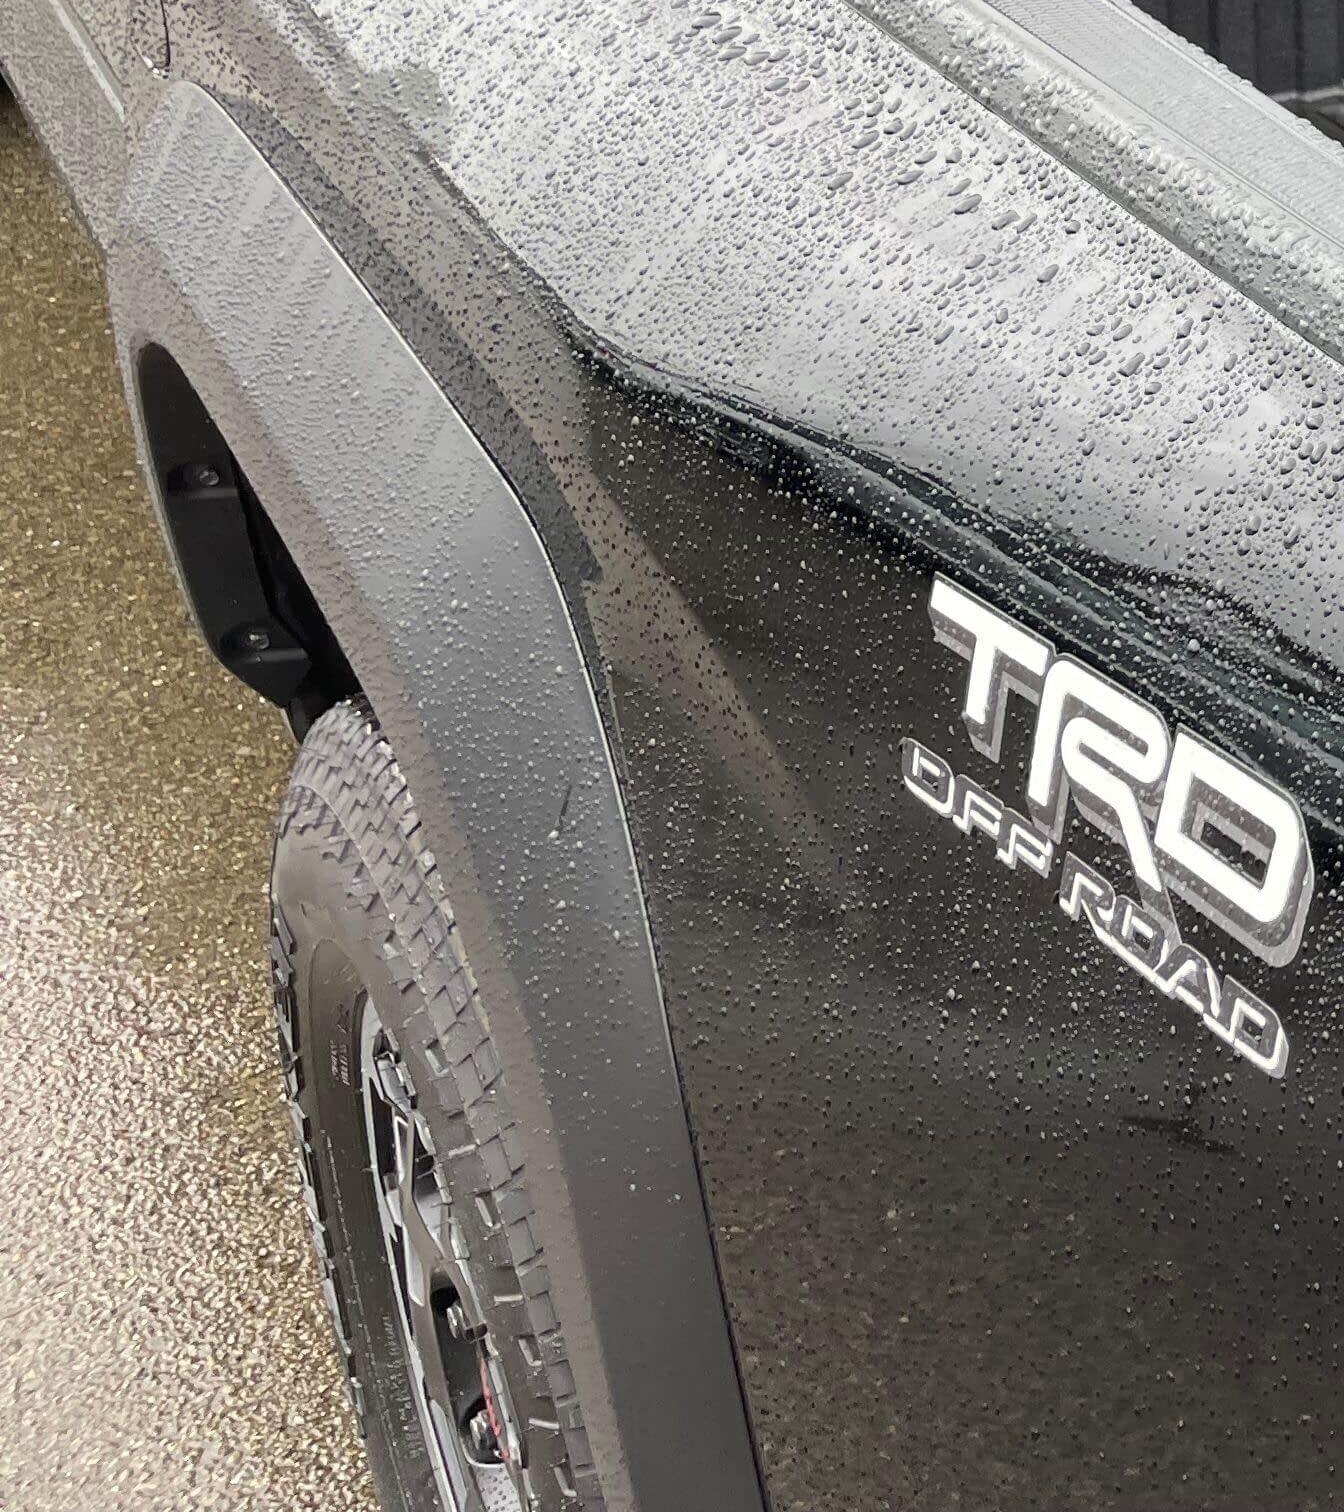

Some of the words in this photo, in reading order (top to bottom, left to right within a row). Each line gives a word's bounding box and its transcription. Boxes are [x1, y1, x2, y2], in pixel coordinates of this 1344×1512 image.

[901, 736, 1054, 878] OFF
[1058, 851, 1290, 1079] ROAD
[928, 571, 1315, 968] TRD
